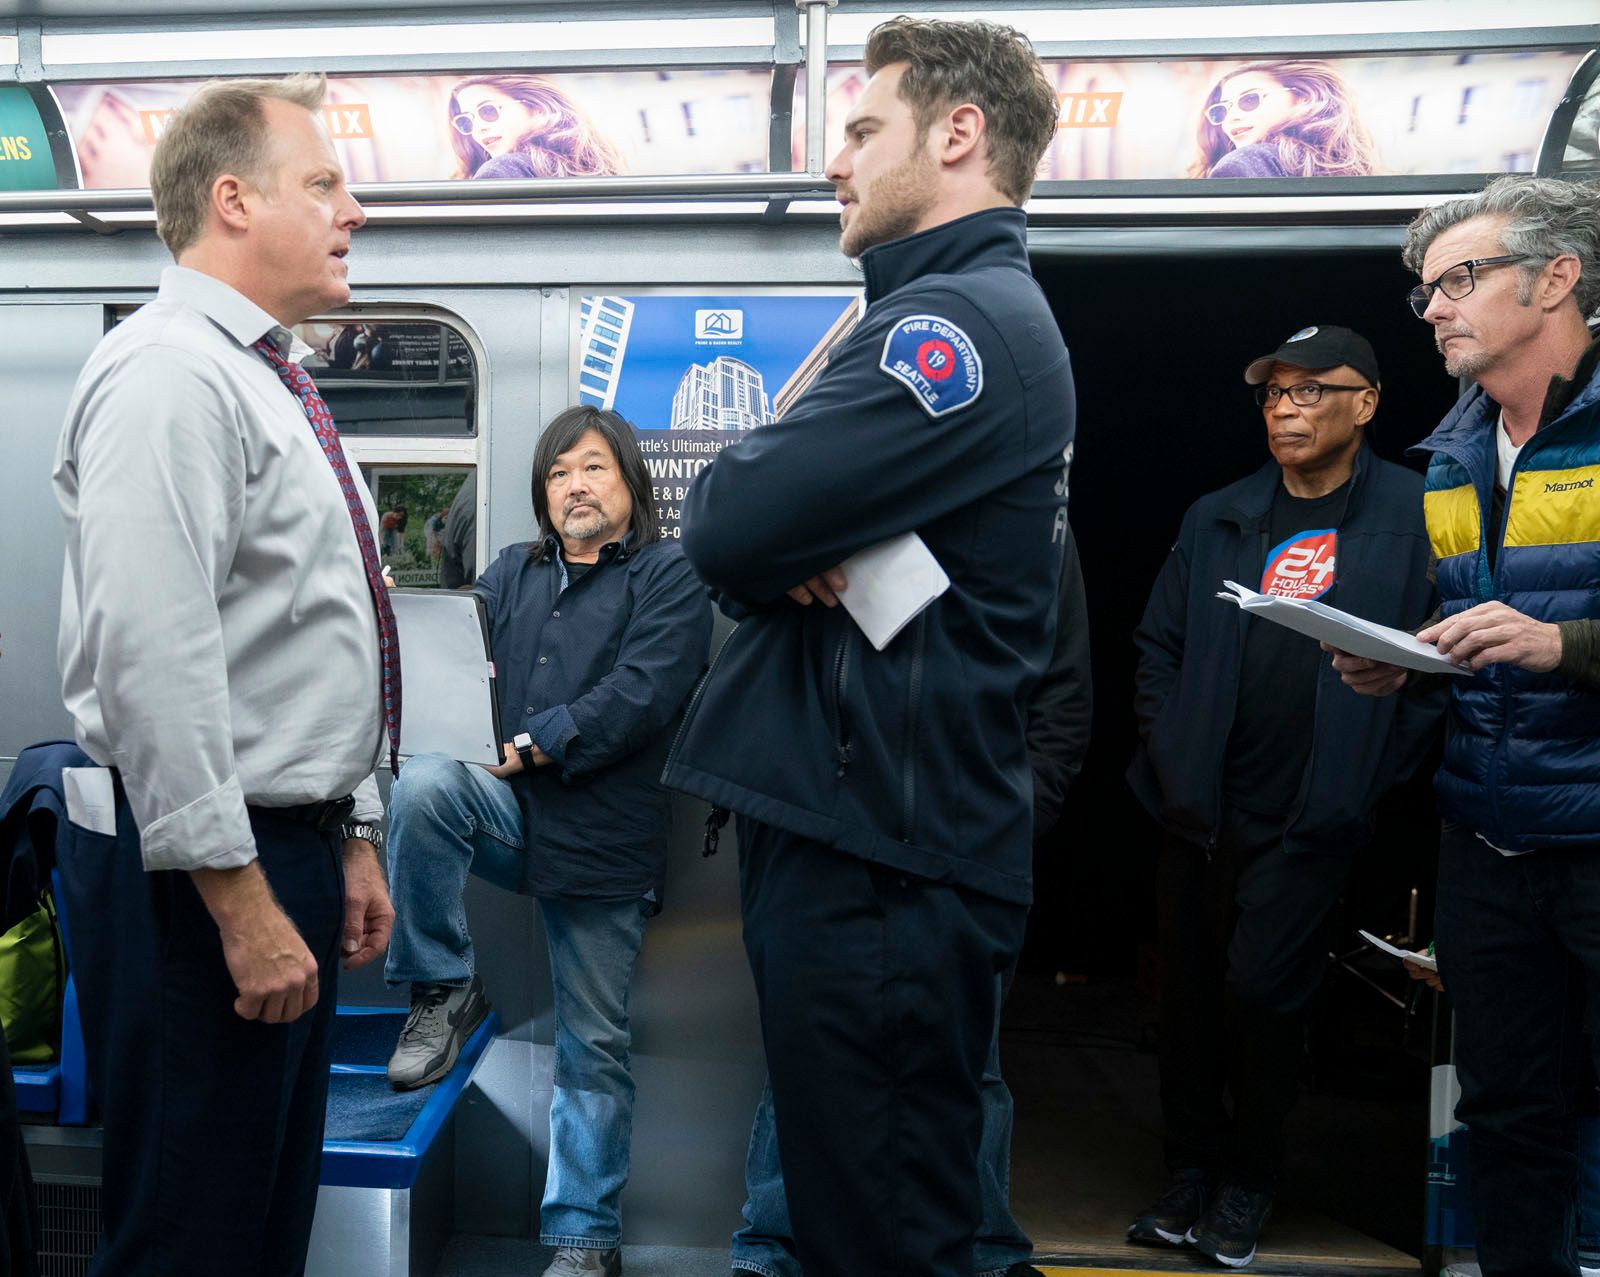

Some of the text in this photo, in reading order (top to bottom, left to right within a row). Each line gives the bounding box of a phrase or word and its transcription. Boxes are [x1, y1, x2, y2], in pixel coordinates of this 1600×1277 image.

[902, 321, 977, 393] FIRE DEPARTMENT
[928, 350, 946, 368] 19
[893, 360, 939, 404] SEATTLE
[672, 439, 722, 453] Ultimate
[662, 486, 672, 500] &
[1543, 477, 1594, 493] Marmot
[659, 526, 681, 538] 5-0
[1275, 544, 1336, 584] 24
